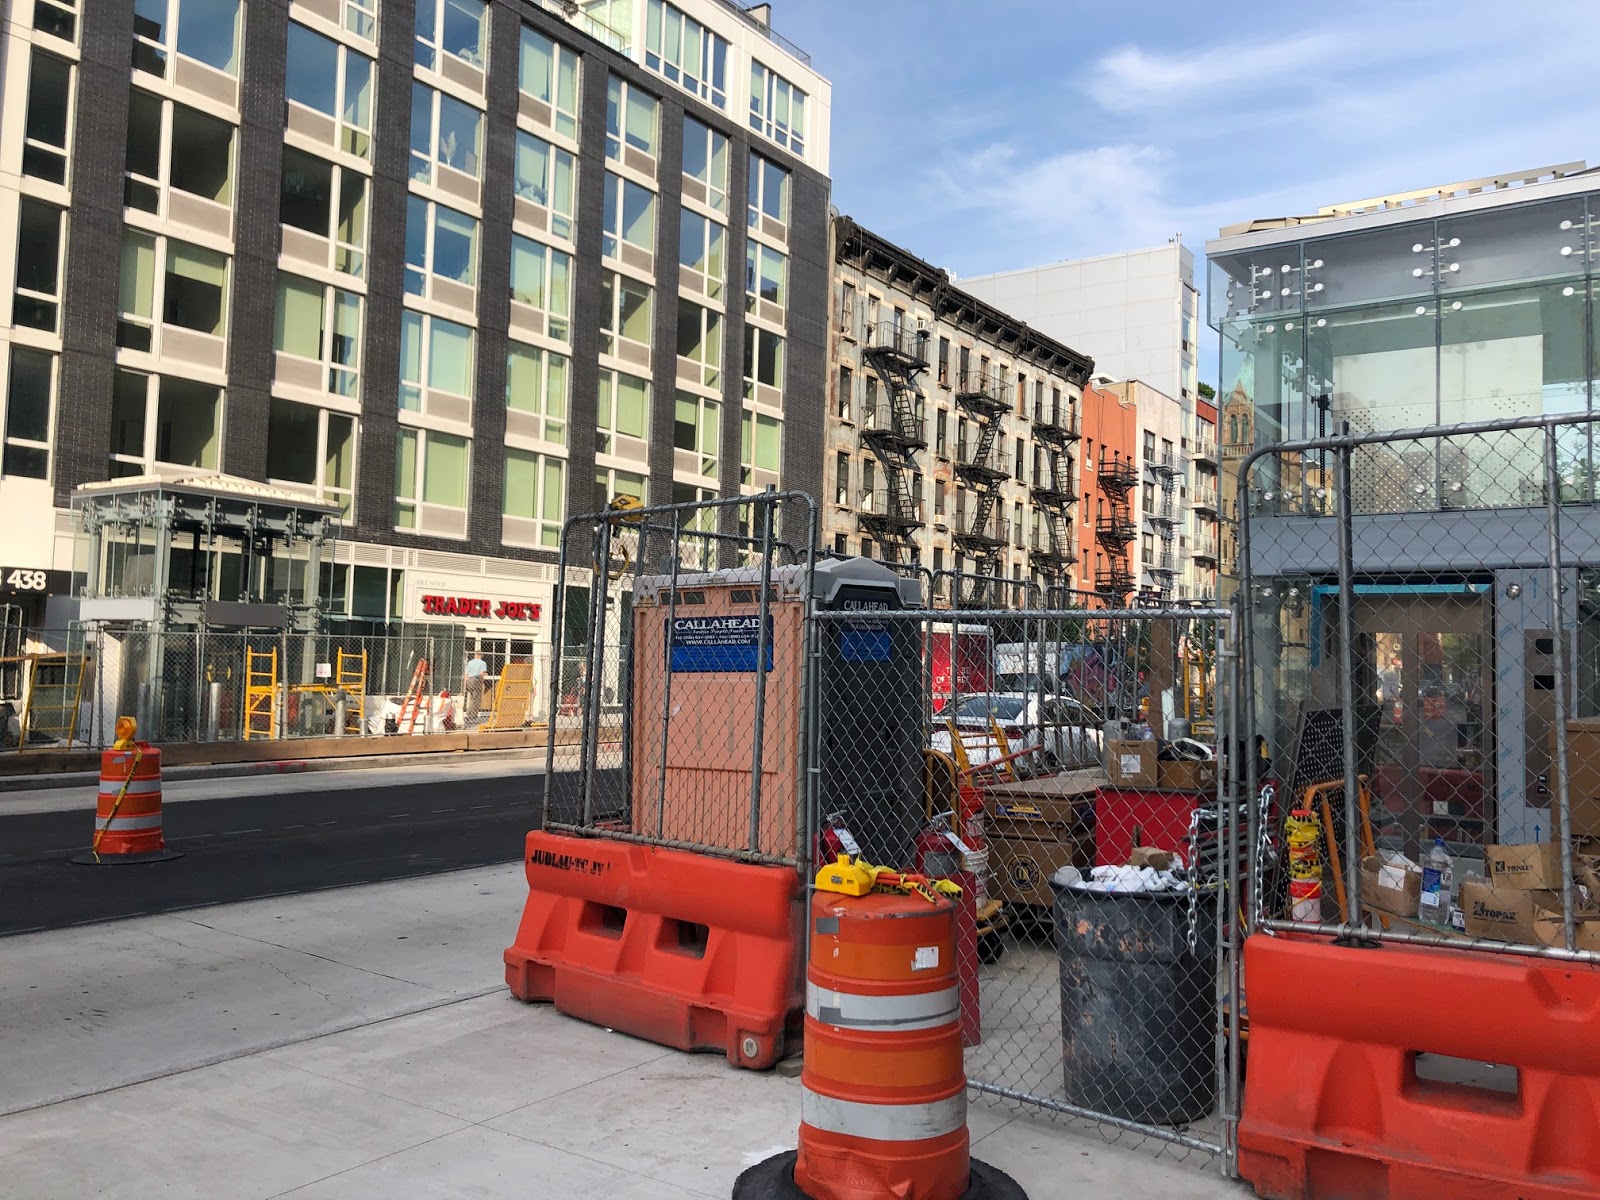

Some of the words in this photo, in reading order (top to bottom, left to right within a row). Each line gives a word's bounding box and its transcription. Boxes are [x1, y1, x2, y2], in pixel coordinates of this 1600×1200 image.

[7, 569, 47, 590] 438
[421, 594, 492, 619] TRADER
[494, 600, 543, 622] JOE'S
[844, 600, 889, 611] CALLAHEAD
[674, 618, 761, 630] CALLAHEAD
[1484, 909, 1516, 920] TOPAZ
